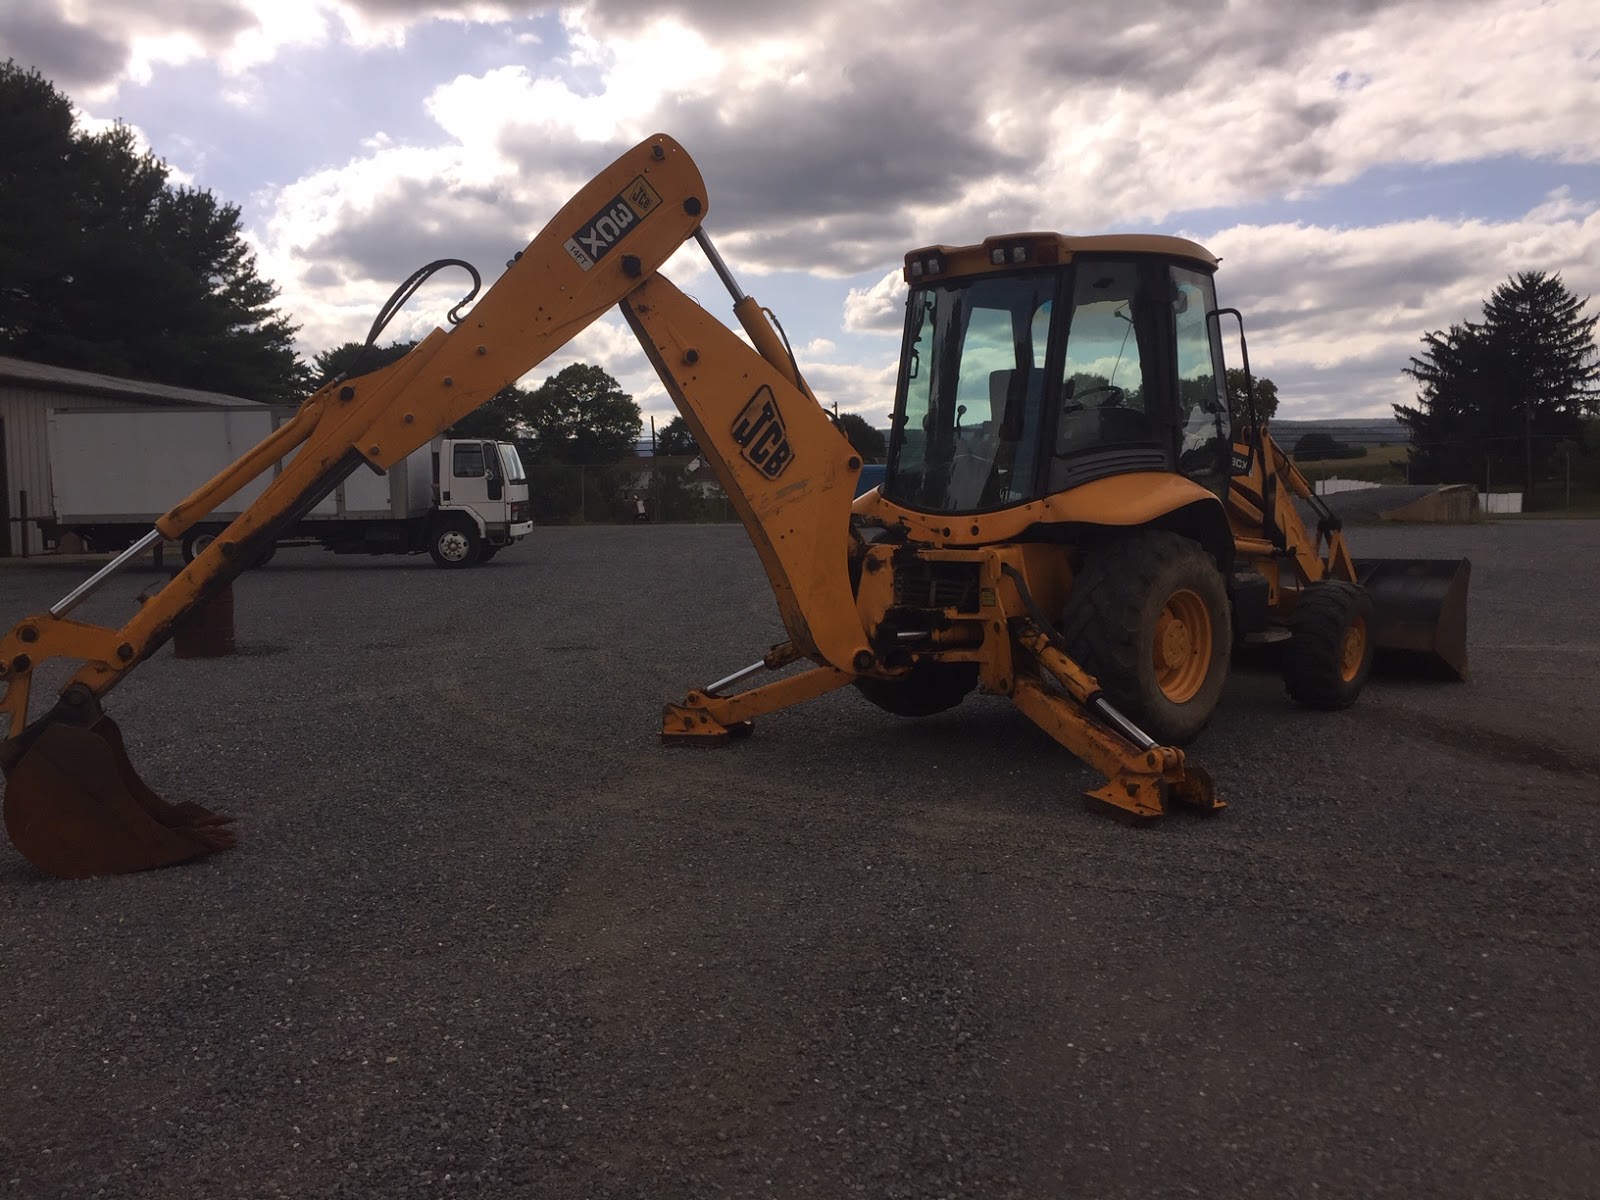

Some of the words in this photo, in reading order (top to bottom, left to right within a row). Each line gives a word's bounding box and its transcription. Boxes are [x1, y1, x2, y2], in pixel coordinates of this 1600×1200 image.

[631, 186, 651, 209] JCB
[579, 203, 634, 258] 3CX
[570, 245, 588, 264] 14FT
[733, 400, 790, 476] JCB
[1232, 456, 1248, 469] 3CX
